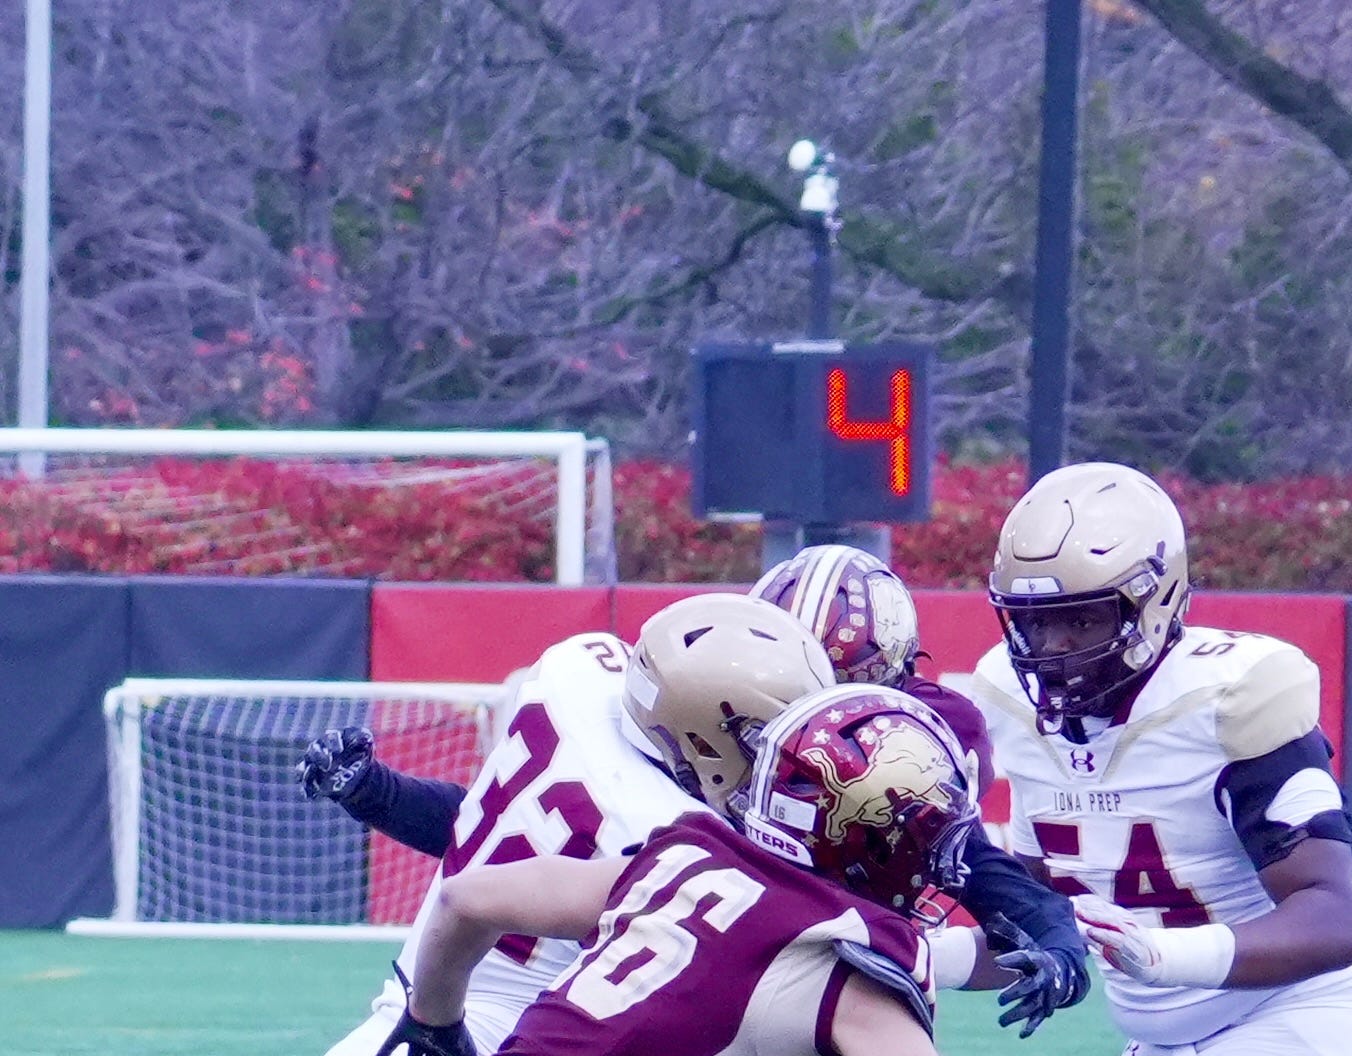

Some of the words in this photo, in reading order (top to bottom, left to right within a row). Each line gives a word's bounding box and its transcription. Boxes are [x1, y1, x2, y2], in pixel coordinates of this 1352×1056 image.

[826, 367, 911, 497] 4
[1053, 792, 1082, 812] IONA
[1089, 793, 1121, 812] PREP
[547, 843, 767, 1021] 16
[1032, 818, 1212, 929] 54
